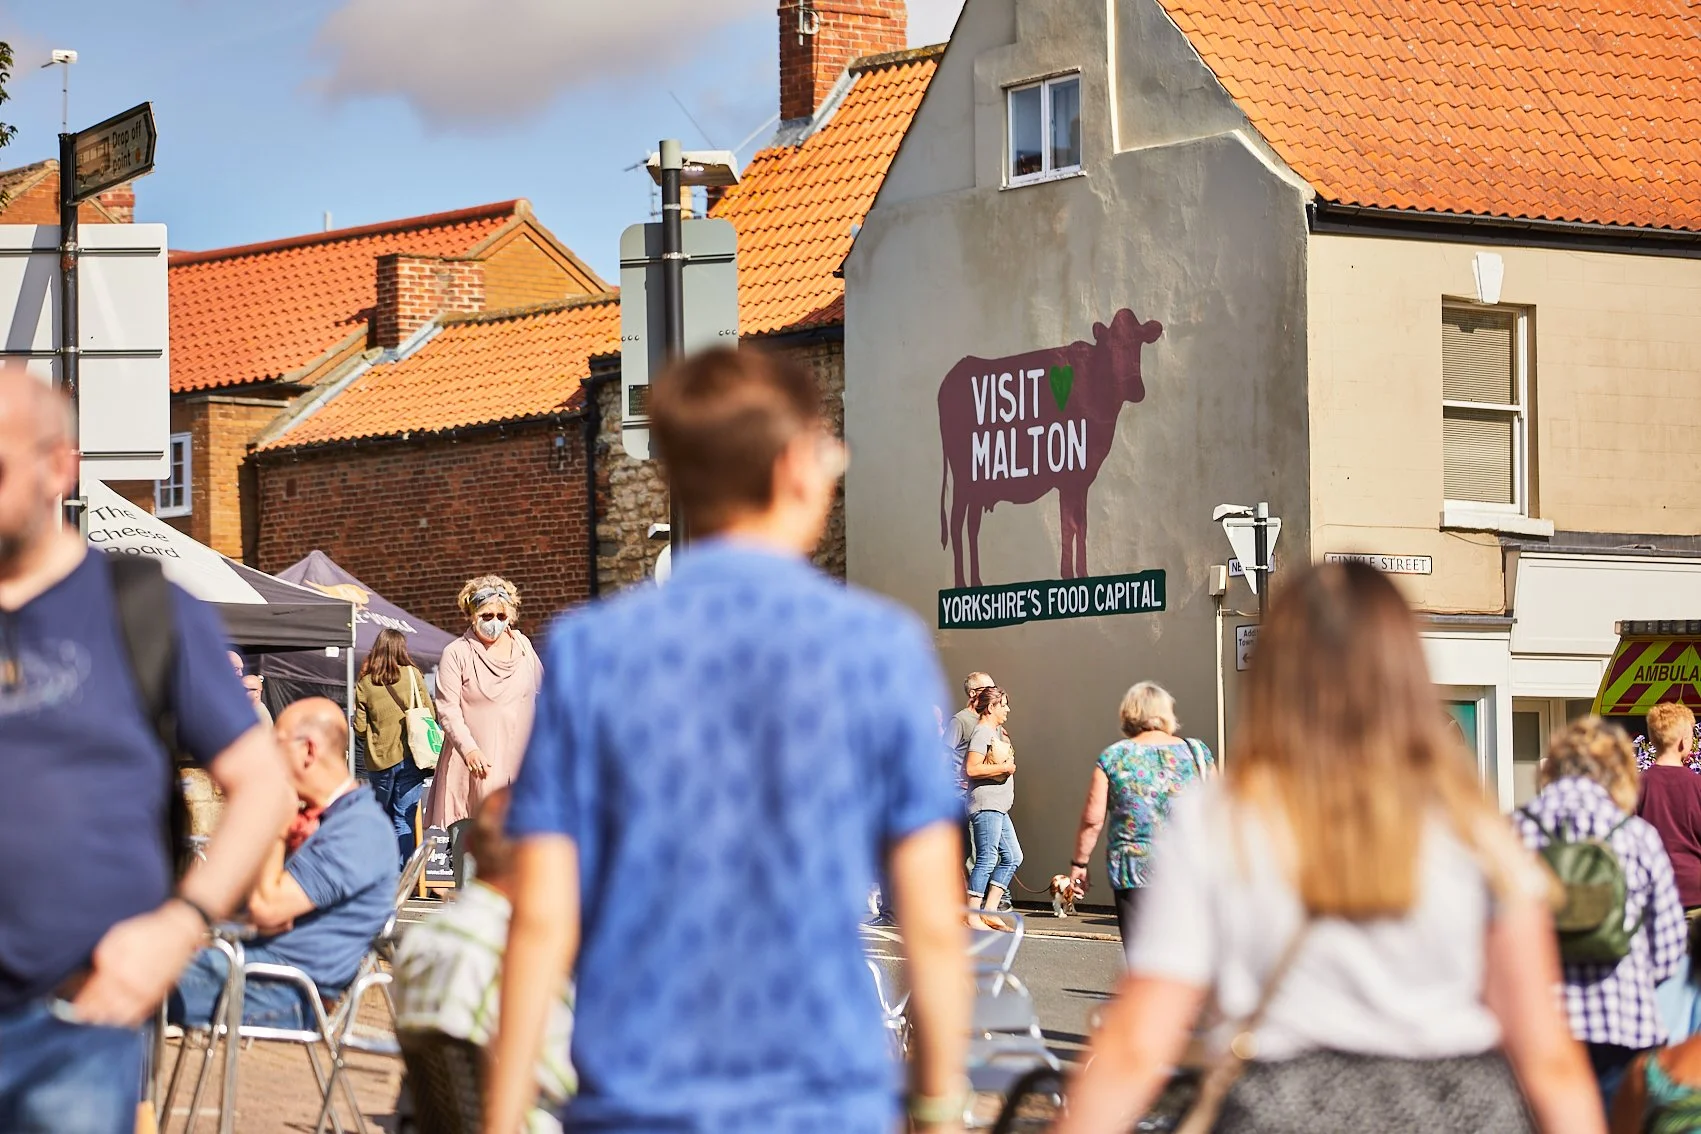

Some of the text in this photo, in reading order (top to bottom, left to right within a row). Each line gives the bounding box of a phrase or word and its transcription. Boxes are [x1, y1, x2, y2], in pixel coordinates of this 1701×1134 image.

[112, 119, 142, 148] Drop off
[112, 149, 131, 175] point
[971, 368, 1045, 425] VISIT
[971, 418, 1087, 481] MALTON
[90, 505, 137, 521] The
[88, 527, 169, 543] Cheese
[1381, 556, 1427, 571] STREET
[942, 579, 1162, 624] YORKSHIRE'S FOOD CAPITAL
[1633, 665, 1701, 682] AMBULA
